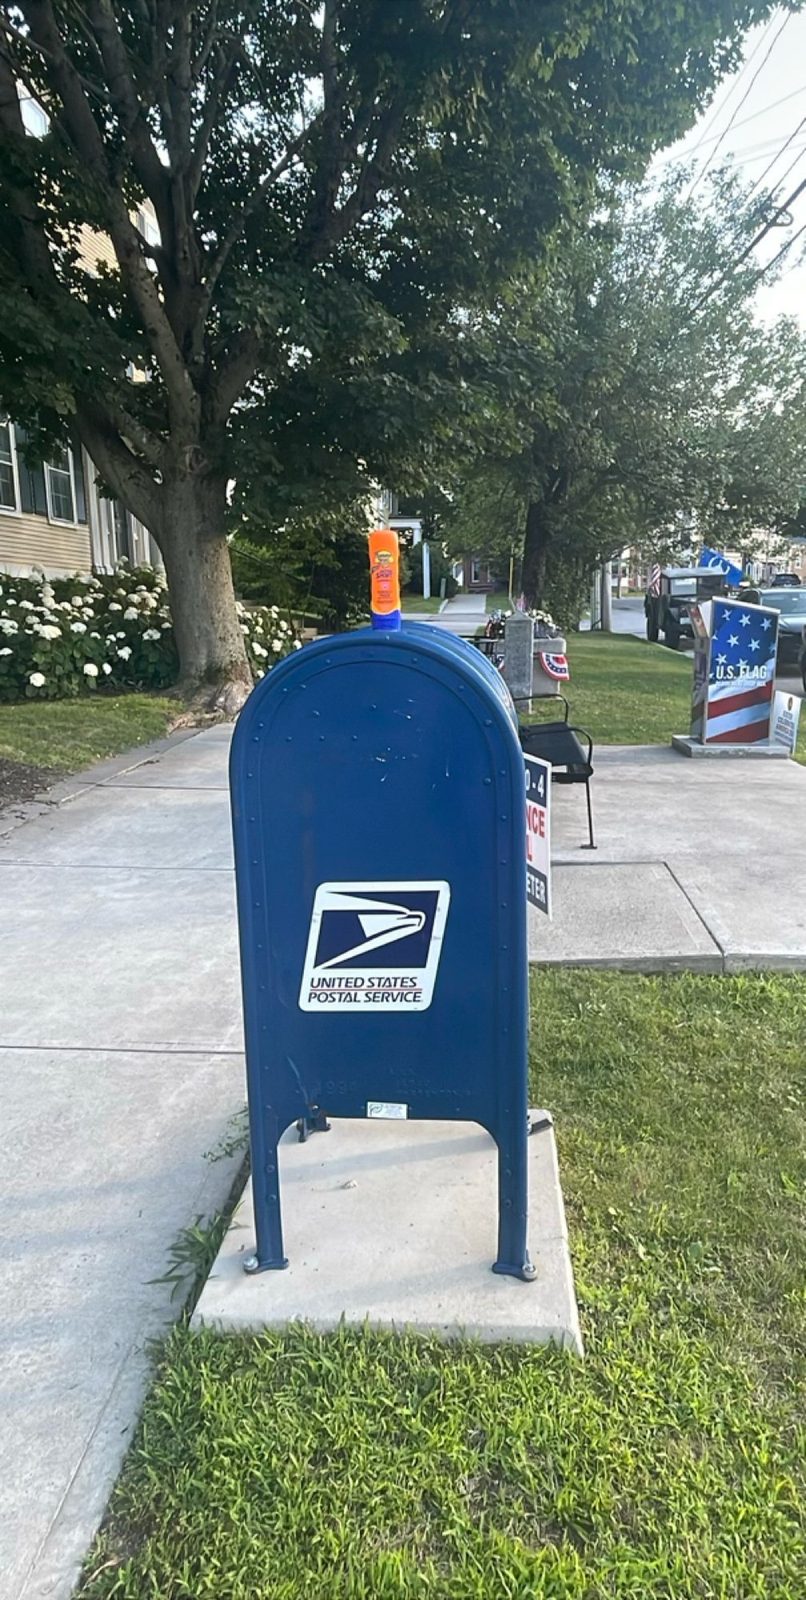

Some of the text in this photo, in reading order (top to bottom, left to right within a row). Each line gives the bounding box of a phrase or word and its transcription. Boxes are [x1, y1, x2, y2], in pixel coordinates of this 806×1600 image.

[716, 665, 767, 679] U.S. FLAG
[310, 976, 418, 988] UNITED STATES
[308, 991, 422, 1003] POSTAL SERVICE
